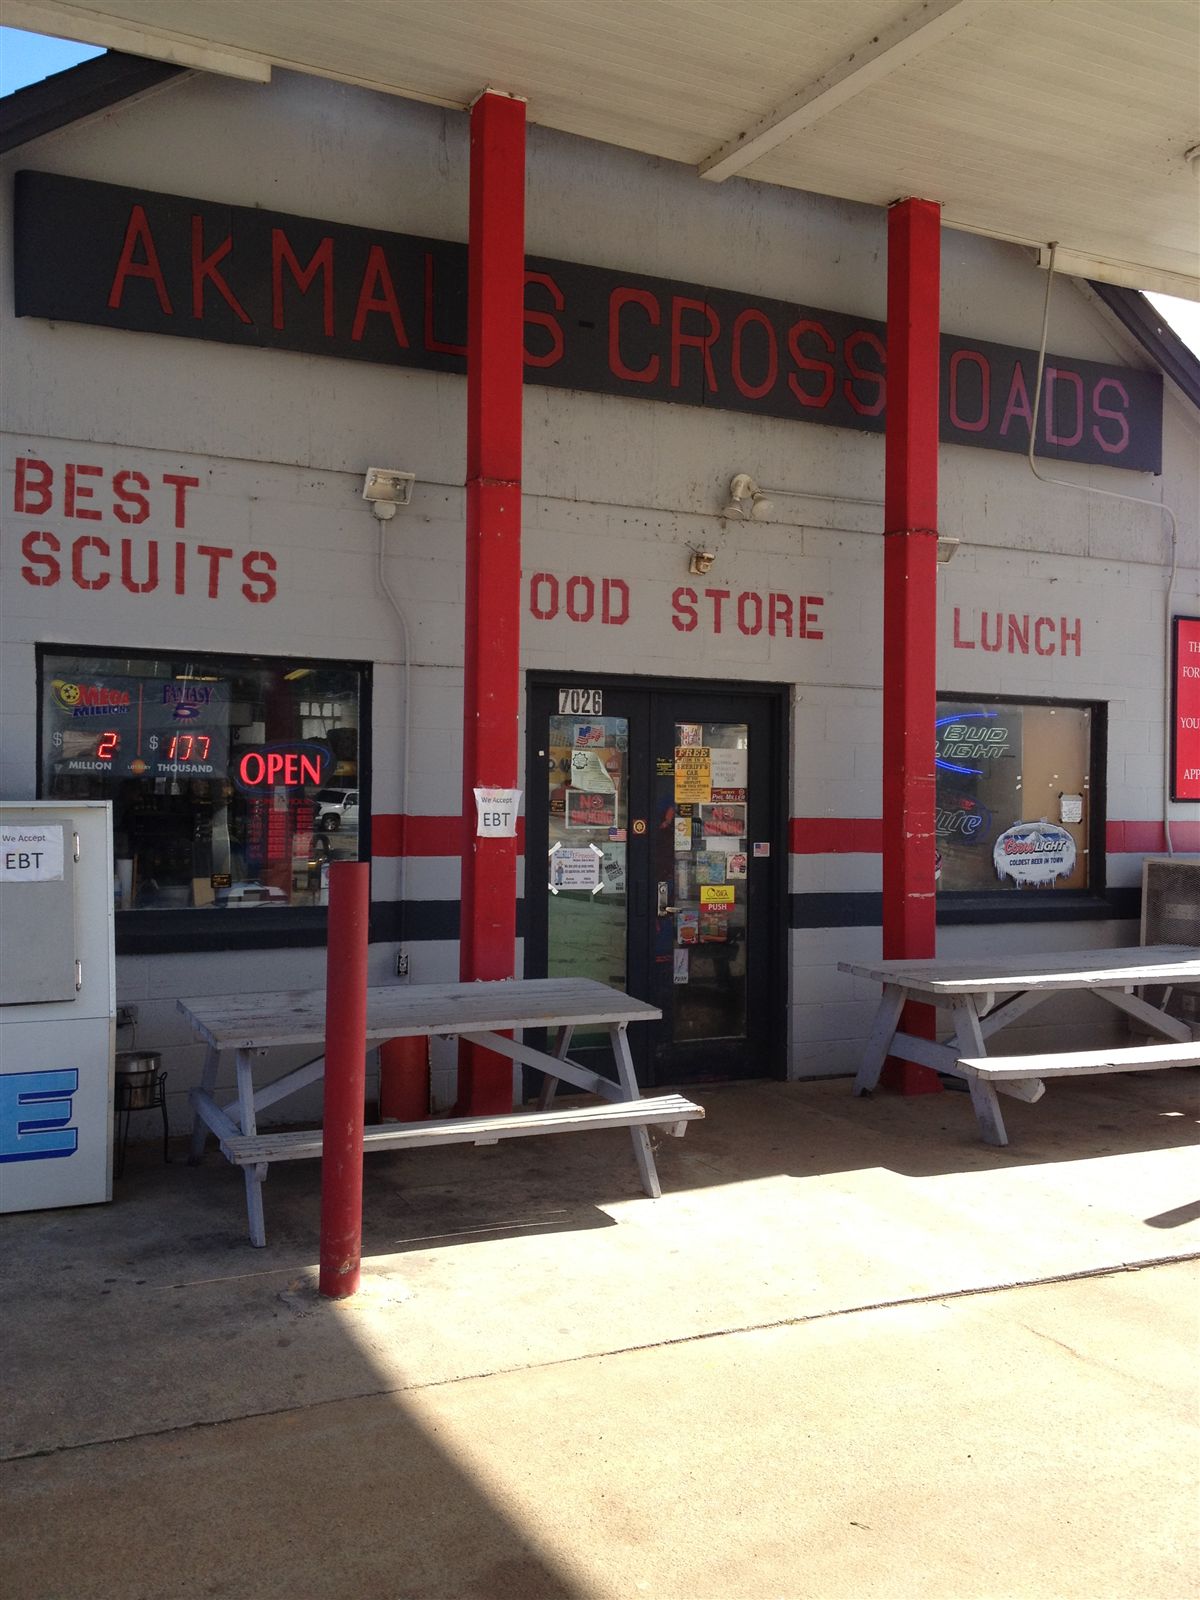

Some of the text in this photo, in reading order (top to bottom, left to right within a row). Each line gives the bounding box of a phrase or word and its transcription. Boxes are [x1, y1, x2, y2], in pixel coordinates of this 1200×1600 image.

[608, 286, 1130, 453] CROSSOADS
[13, 457, 199, 528] BEST
[21, 532, 277, 603] SCUITS
[522, 571, 824, 640] OOD STORE
[953, 607, 1082, 657] LUNCH
[163, 684, 214, 704] FANTASY
[560, 690, 602, 714] 7026
[943, 725, 1009, 742] BUD
[97, 731, 118, 759] 2
[149, 735, 159, 750] $
[678, 749, 708, 757] FREE
[69, 761, 112, 771] MILLION
[157, 763, 213, 773] THOUSAND
[239, 752, 321, 785] OPEN
[493, 797, 513, 805] Accept
[483, 812, 511, 827] EBT
[2, 834, 46, 843] We Accept
[1035, 840, 1066, 852] LIGHT
[5, 852, 44, 870] EBT
[1009, 858, 1030, 866] COLDEST
[1031, 857, 1043, 865] BEER
[708, 903, 727, 911] PUSH
[0, 1068, 78, 1164] E
